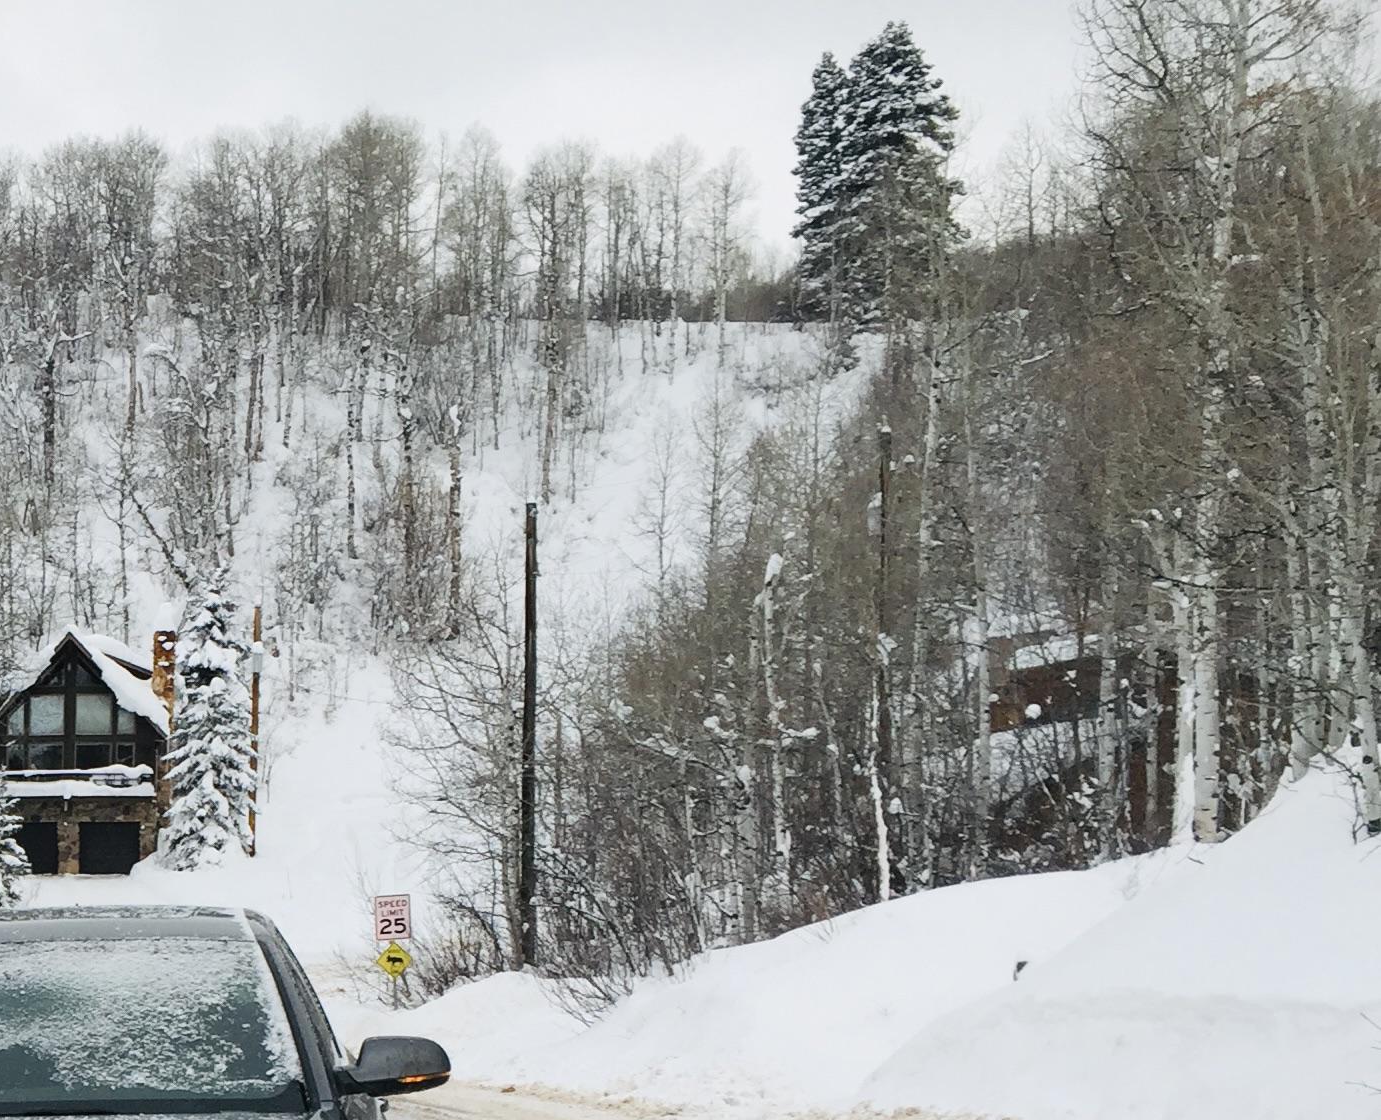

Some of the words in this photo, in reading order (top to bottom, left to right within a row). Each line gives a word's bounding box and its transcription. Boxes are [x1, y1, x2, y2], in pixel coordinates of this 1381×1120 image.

[378, 900, 407, 908] SPEED
[381, 909, 404, 917] LIMIT
[379, 917, 407, 935] 25
